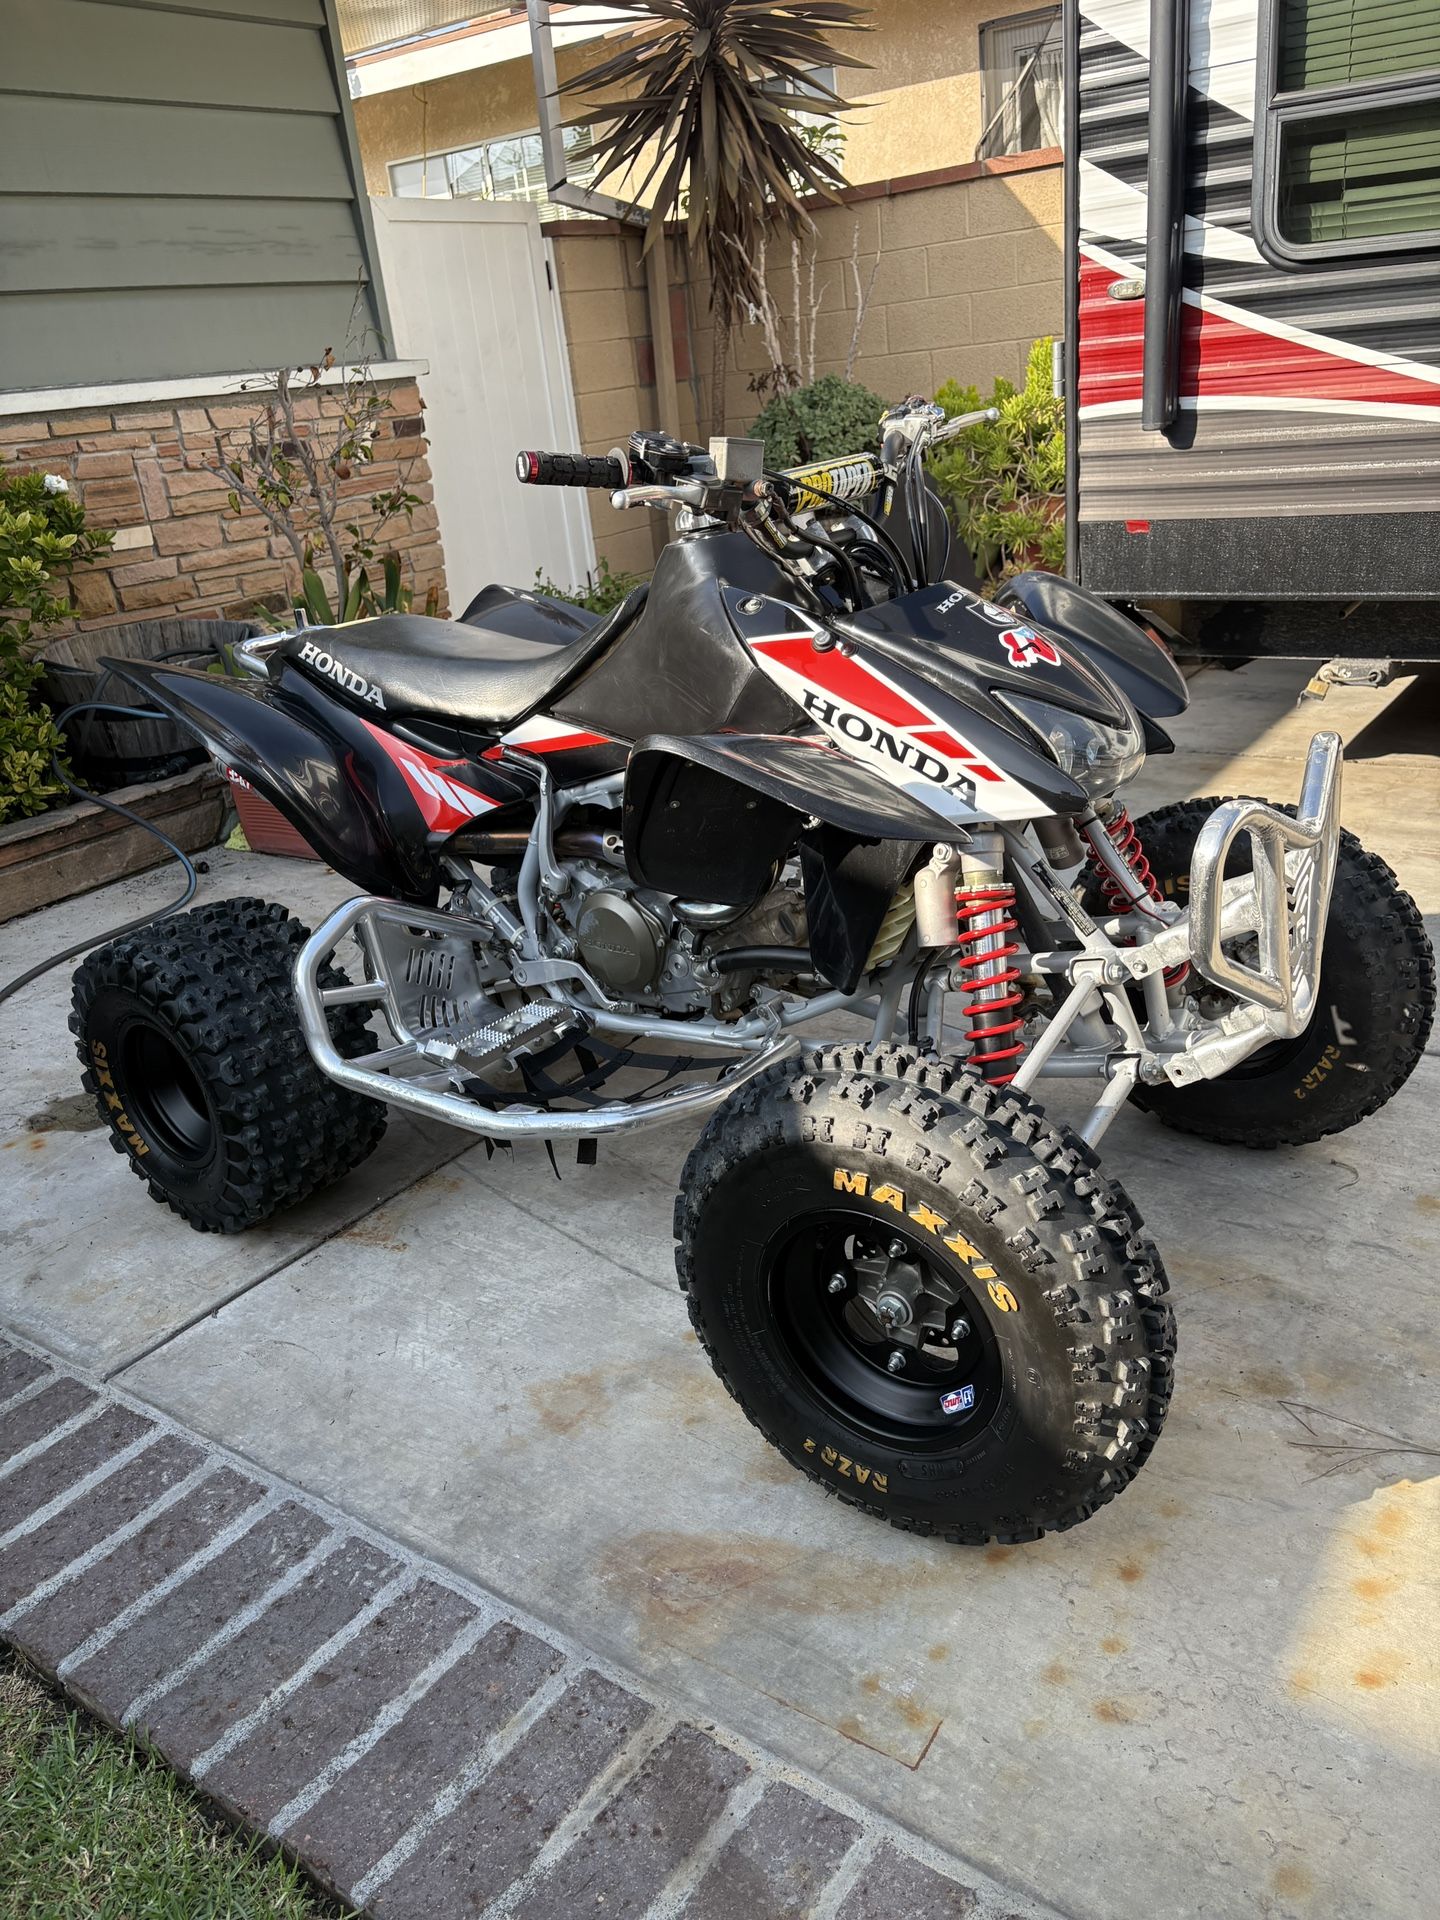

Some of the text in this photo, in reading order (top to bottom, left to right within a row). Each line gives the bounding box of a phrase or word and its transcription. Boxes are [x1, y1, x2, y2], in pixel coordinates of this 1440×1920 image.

[298, 641, 387, 711] HONDA
[803, 688, 978, 813] HONDA
[91, 1039, 150, 1157] MAXXIS
[1293, 1044, 1341, 1100] RAZR 2
[833, 1167, 1020, 1313] MAXXIS
[802, 1438, 889, 1494] RAZR 2
